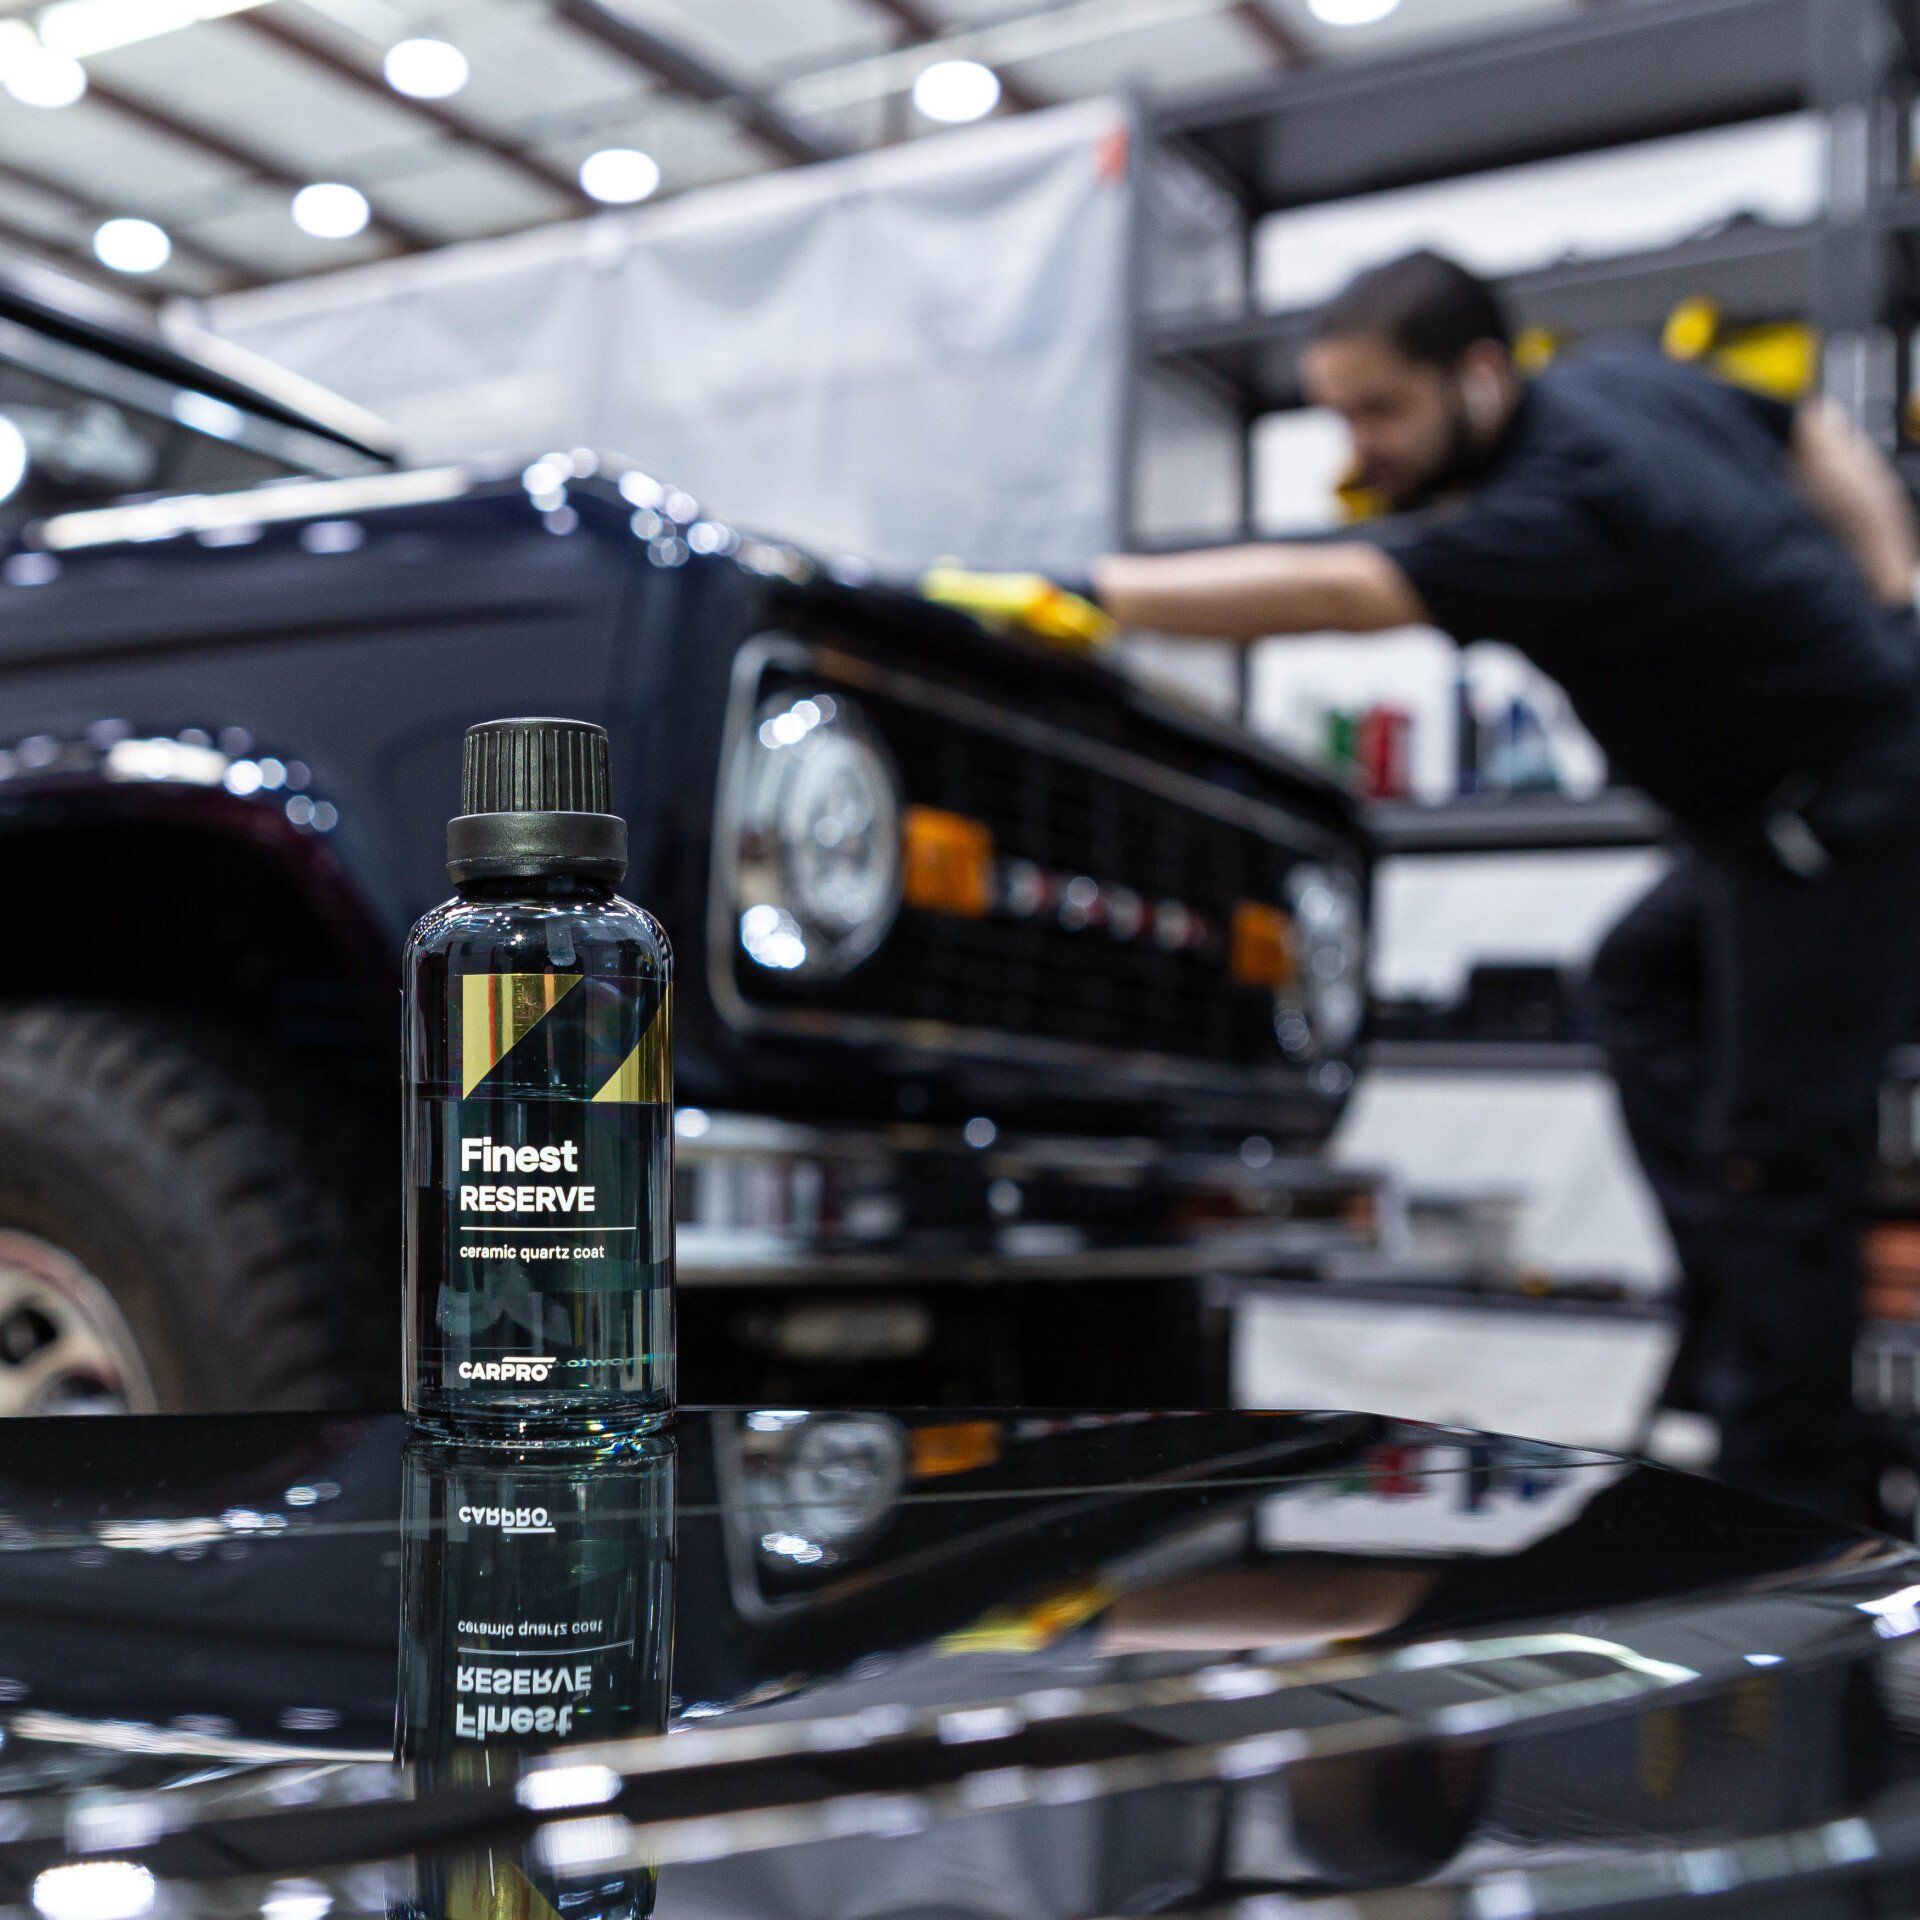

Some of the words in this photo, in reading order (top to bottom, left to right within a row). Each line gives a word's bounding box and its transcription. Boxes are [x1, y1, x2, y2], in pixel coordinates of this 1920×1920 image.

[460, 1136, 578, 1173] Finest
[460, 1185, 596, 1213] RESERVE
[459, 1243, 517, 1260] ceramic
[519, 1246, 570, 1263] quartz
[572, 1244, 605, 1260] coat
[458, 1359, 554, 1382] CARPRO
